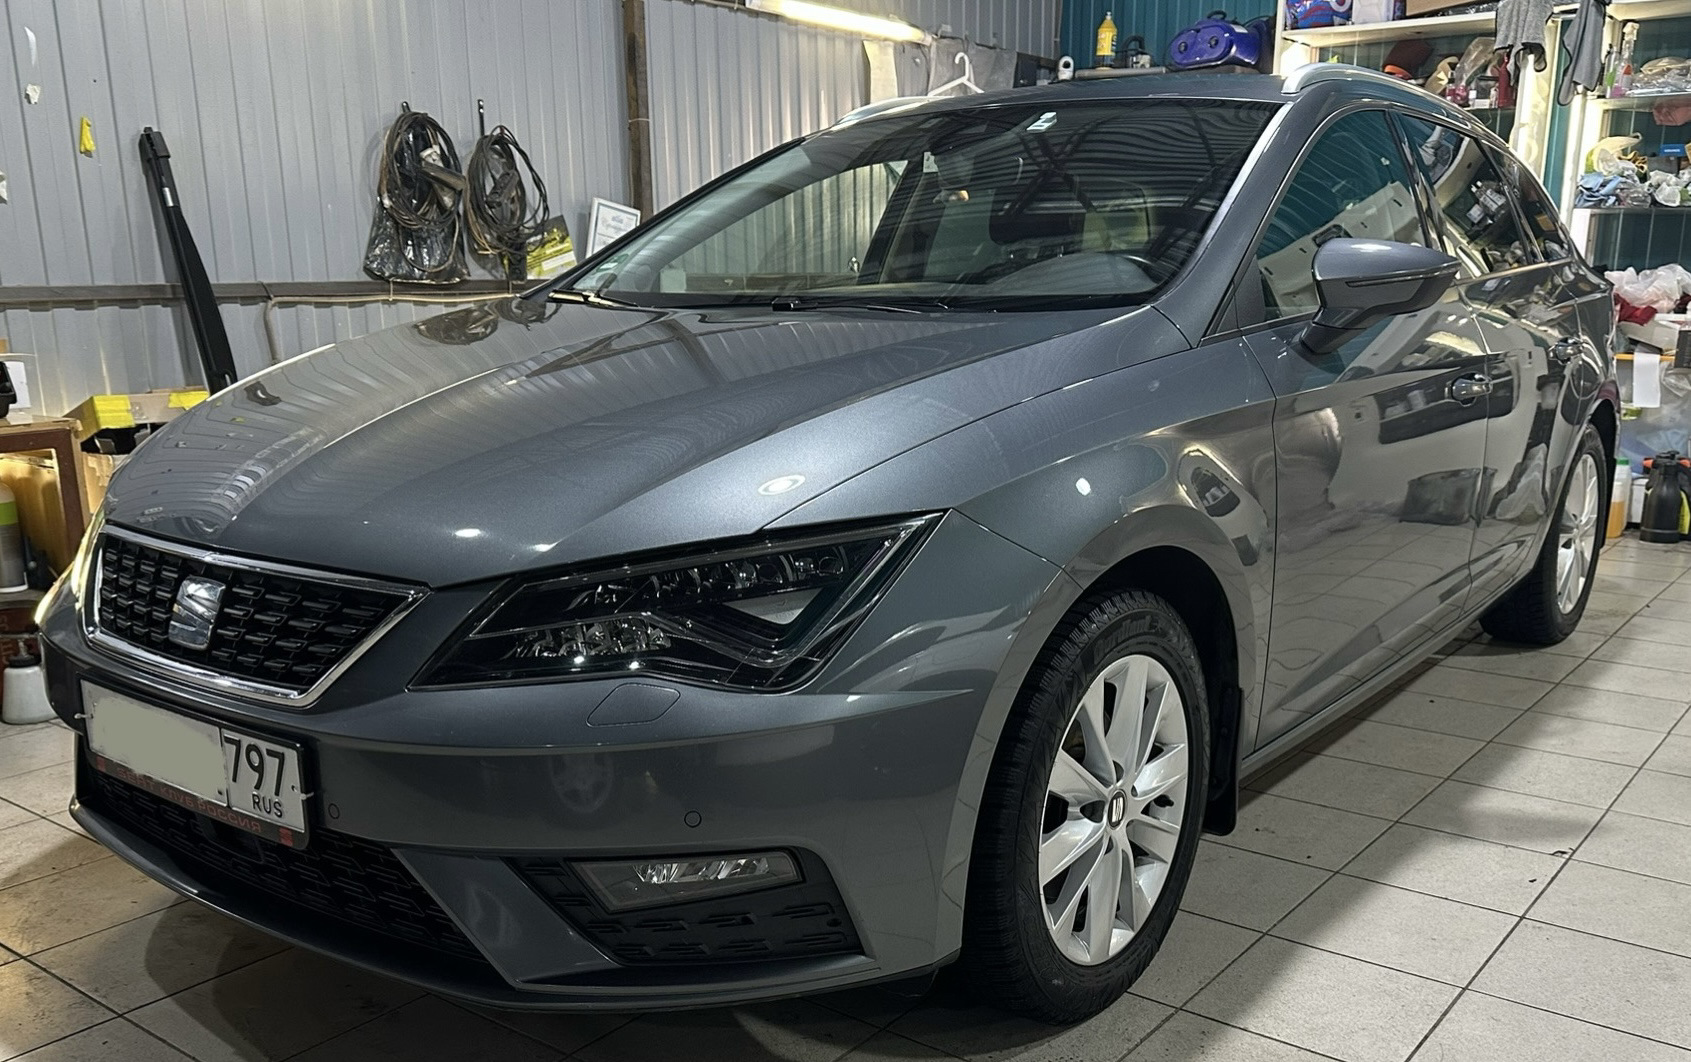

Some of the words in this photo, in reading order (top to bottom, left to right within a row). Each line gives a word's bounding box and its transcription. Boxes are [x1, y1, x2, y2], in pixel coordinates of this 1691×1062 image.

[222, 735, 285, 797] 797
[159, 786, 195, 808] КЛУБ
[196, 799, 263, 833] РОССИЯ
[252, 793, 283, 818] RUS
